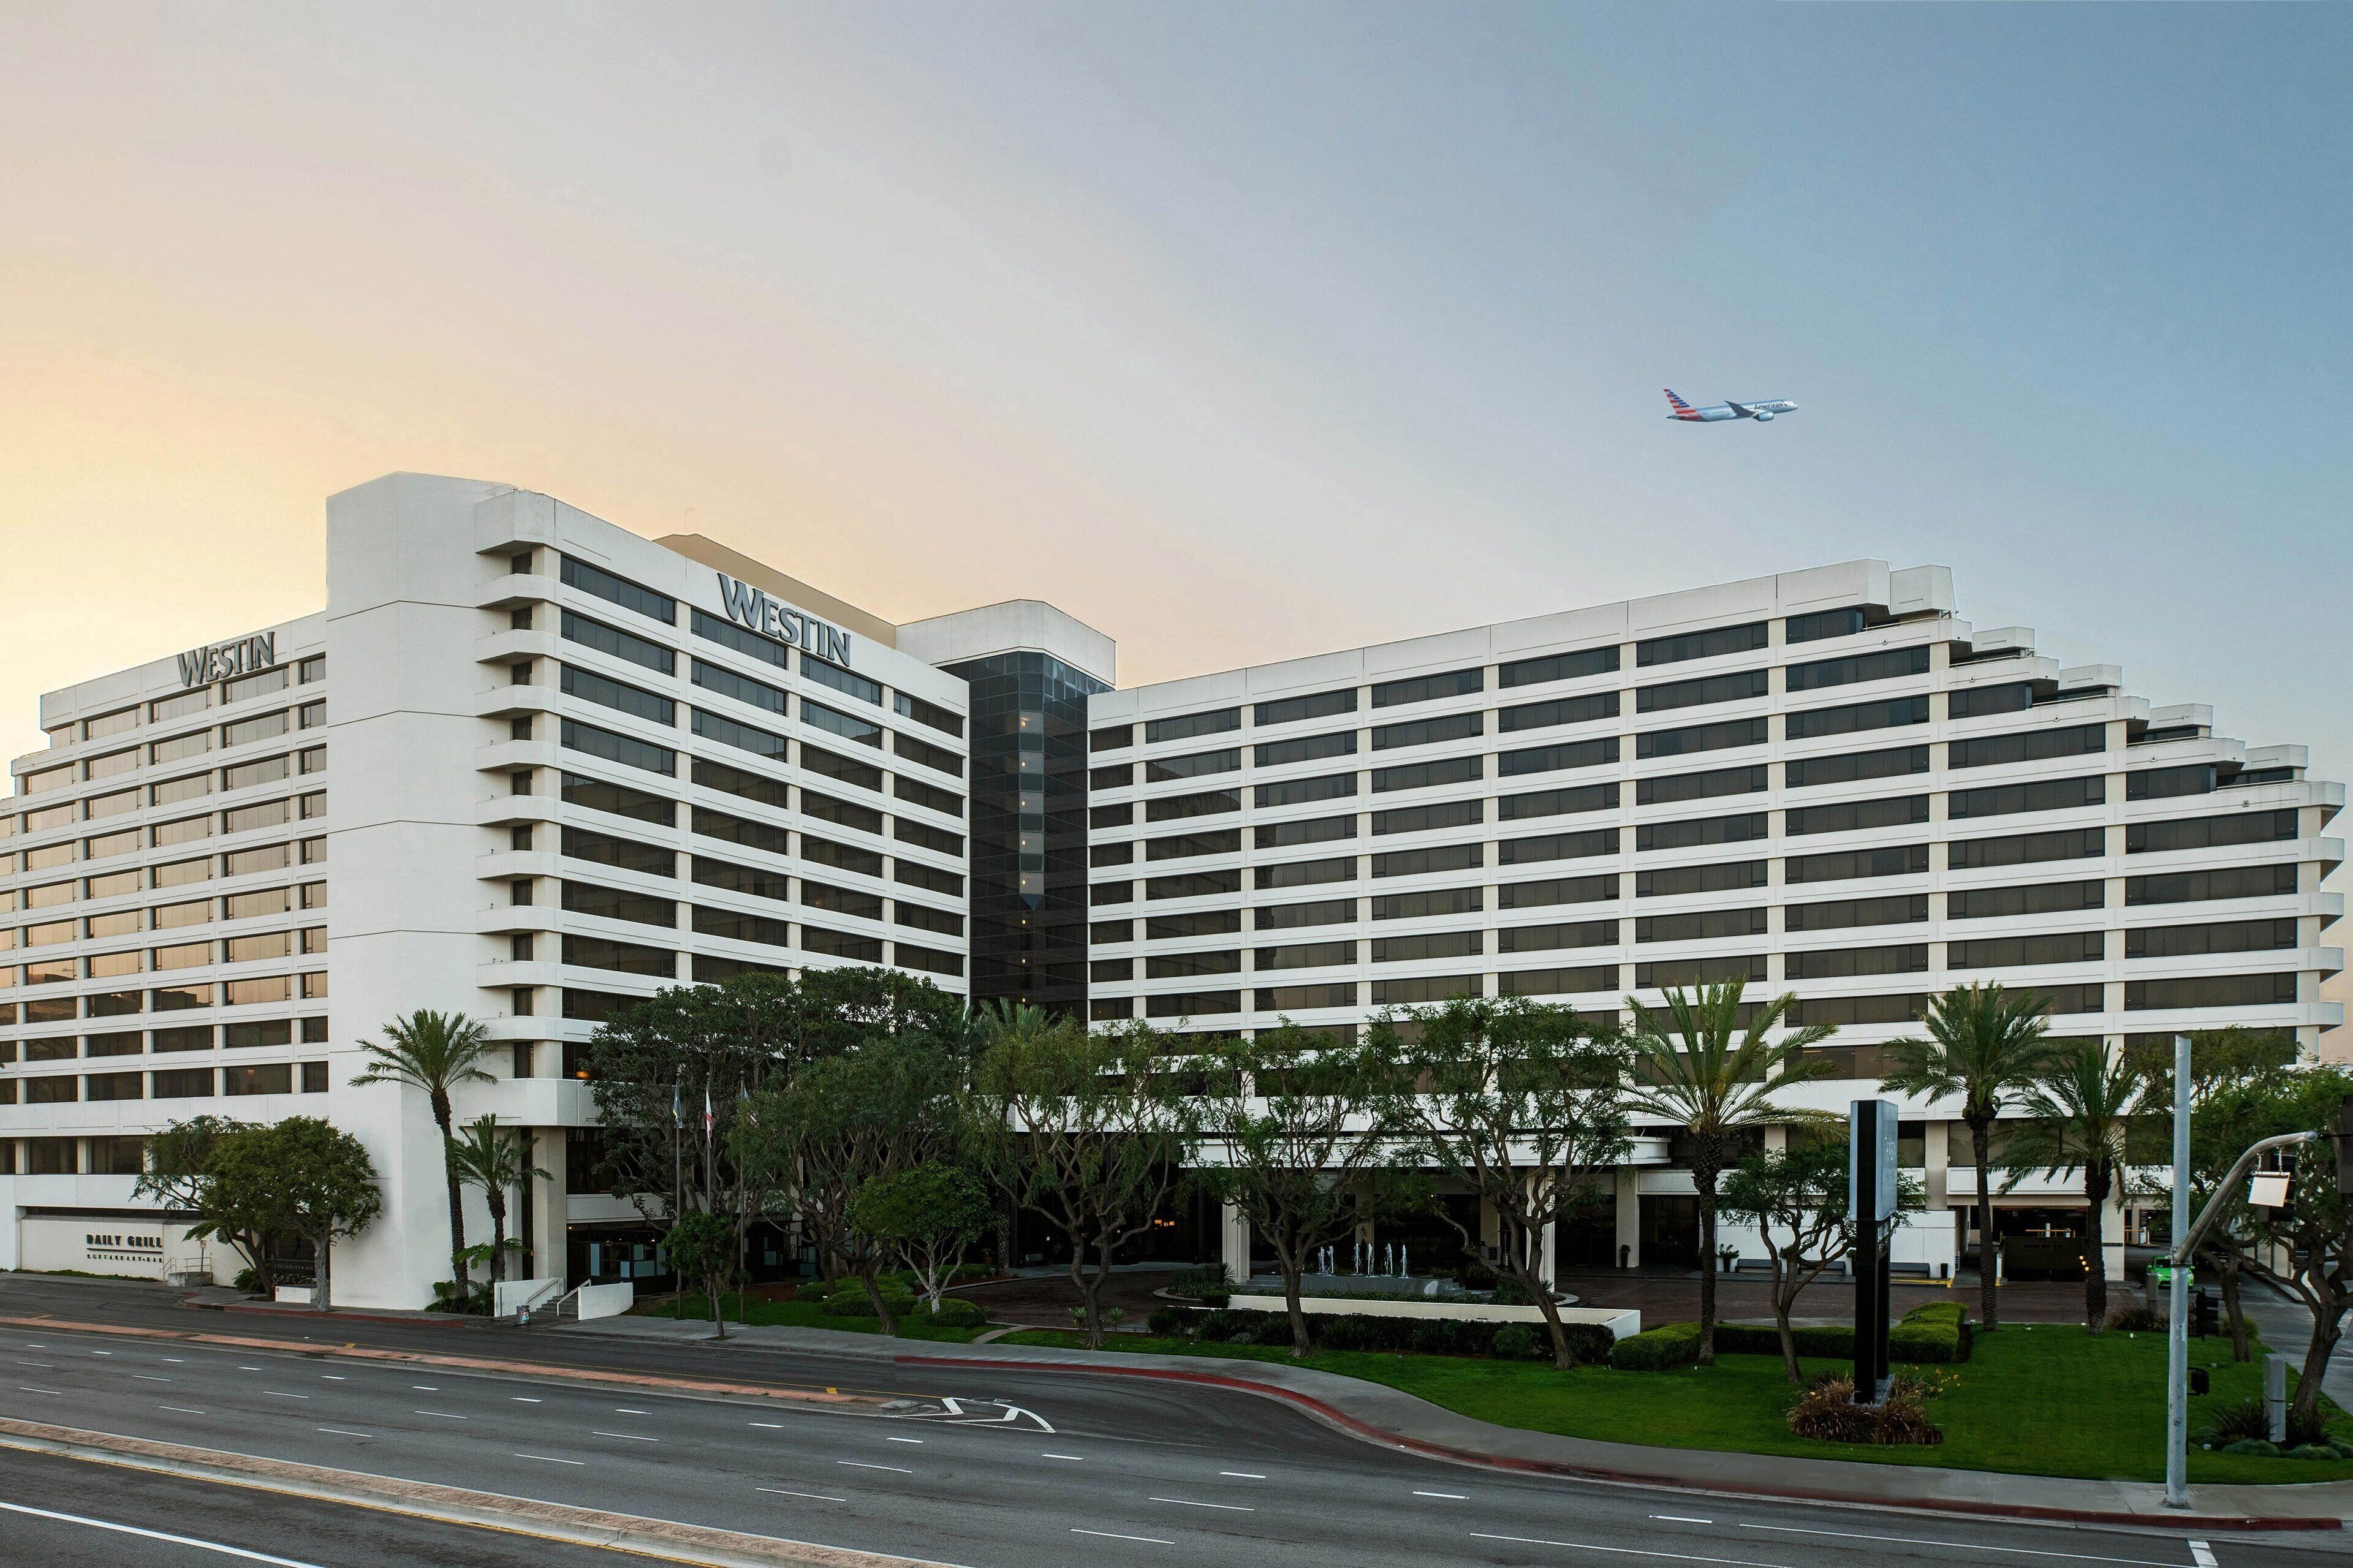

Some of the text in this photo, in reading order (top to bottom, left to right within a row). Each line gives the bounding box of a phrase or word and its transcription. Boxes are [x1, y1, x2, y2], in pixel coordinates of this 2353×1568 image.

[718, 573, 851, 667] WESTIN
[177, 632, 275, 687] WESTIN
[86, 1234, 162, 1247] DAILY GRILL
